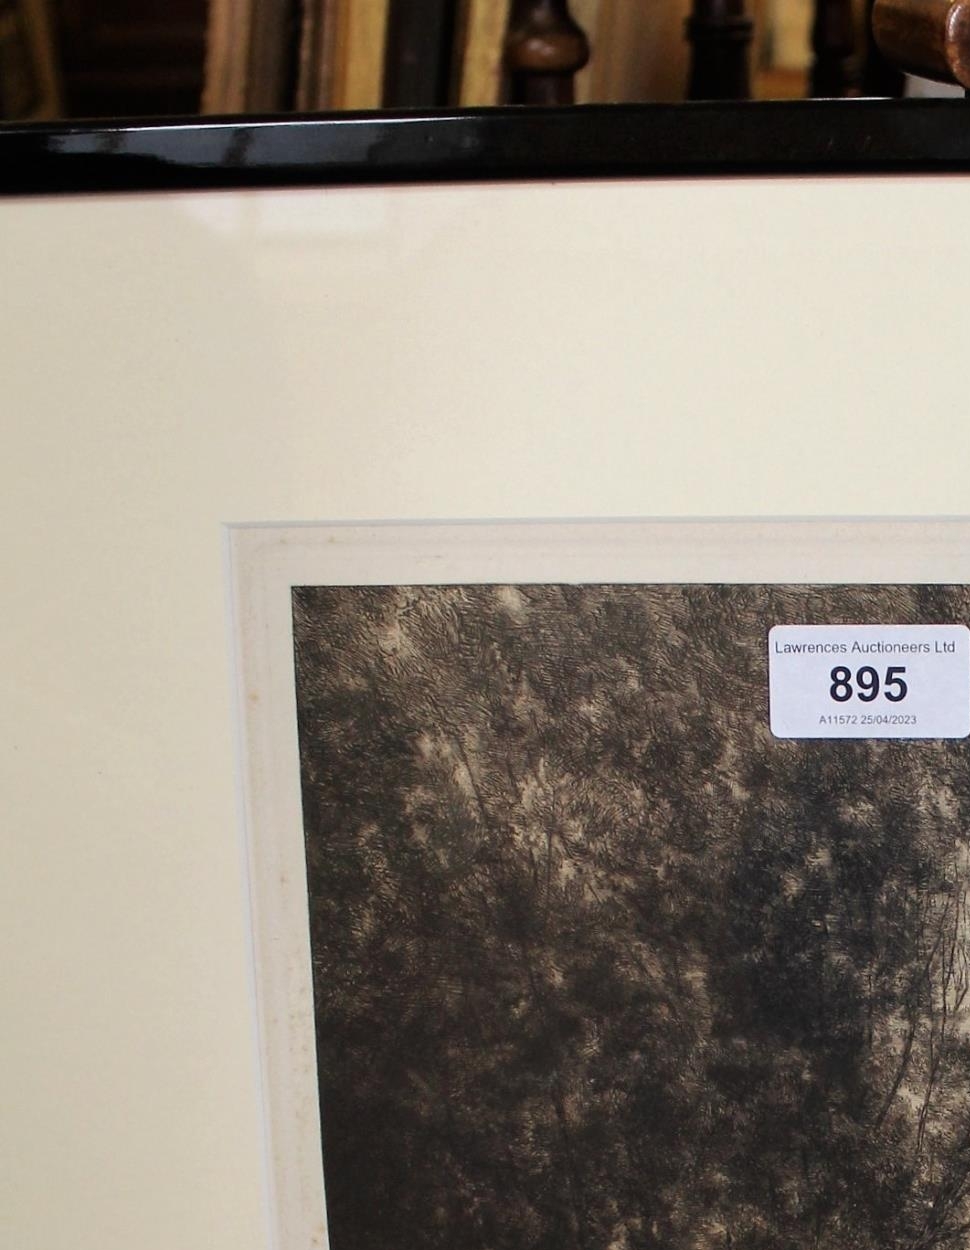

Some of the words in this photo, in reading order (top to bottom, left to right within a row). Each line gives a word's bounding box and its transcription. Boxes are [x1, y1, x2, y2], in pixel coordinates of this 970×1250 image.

[775, 640, 847, 654] Lawrences
[851, 640, 931, 654] Auctioneers
[934, 640, 956, 653] Ltd
[829, 665, 908, 703] 895
[818, 714, 858, 725] A11572
[860, 714, 917, 725] 25/04/2023
